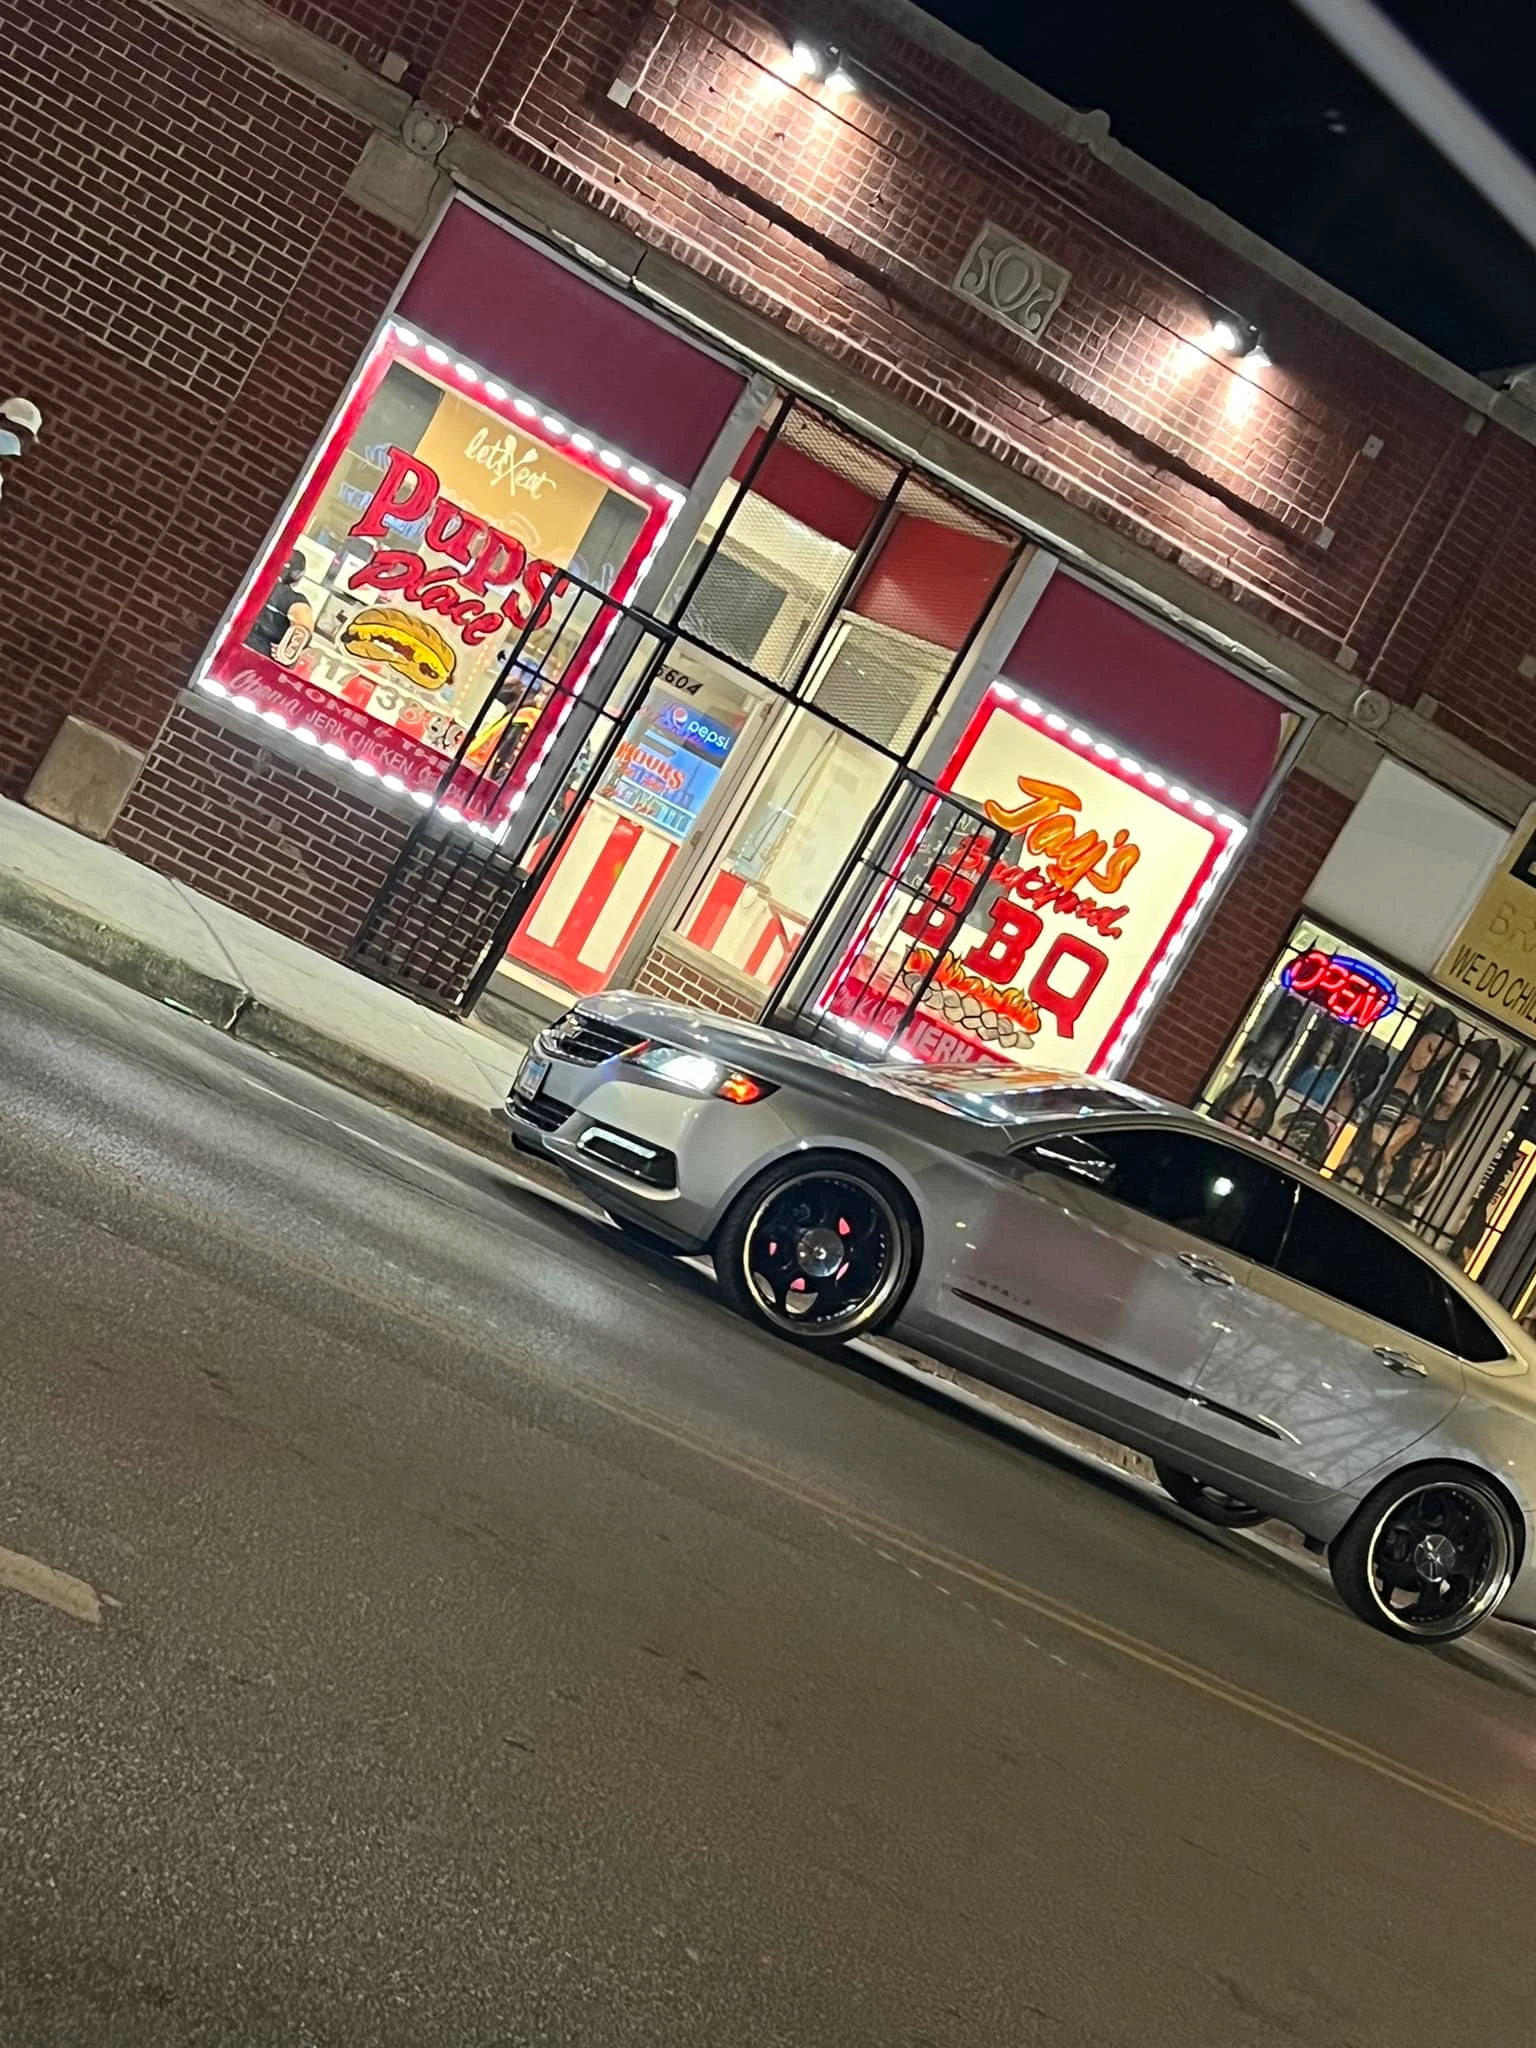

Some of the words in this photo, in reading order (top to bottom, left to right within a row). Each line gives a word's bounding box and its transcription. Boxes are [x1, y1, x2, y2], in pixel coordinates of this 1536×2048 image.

[512, 466, 555, 498] eat
[348, 446, 573, 629] Pups
[277, 673, 370, 729] HOME
[401, 738, 450, 771] THE
[303, 707, 349, 741] JERK
[350, 731, 413, 774] CHICKEN
[686, 720, 730, 749] pepsi
[985, 776, 1142, 893] Jay's
[898, 864, 1110, 1039] BBQ
[1286, 949, 1387, 1031] OPEN
[1451, 946, 1485, 985] WE
[1476, 961, 1513, 1002] DO
[1500, 976, 1536, 1025] CHIL
